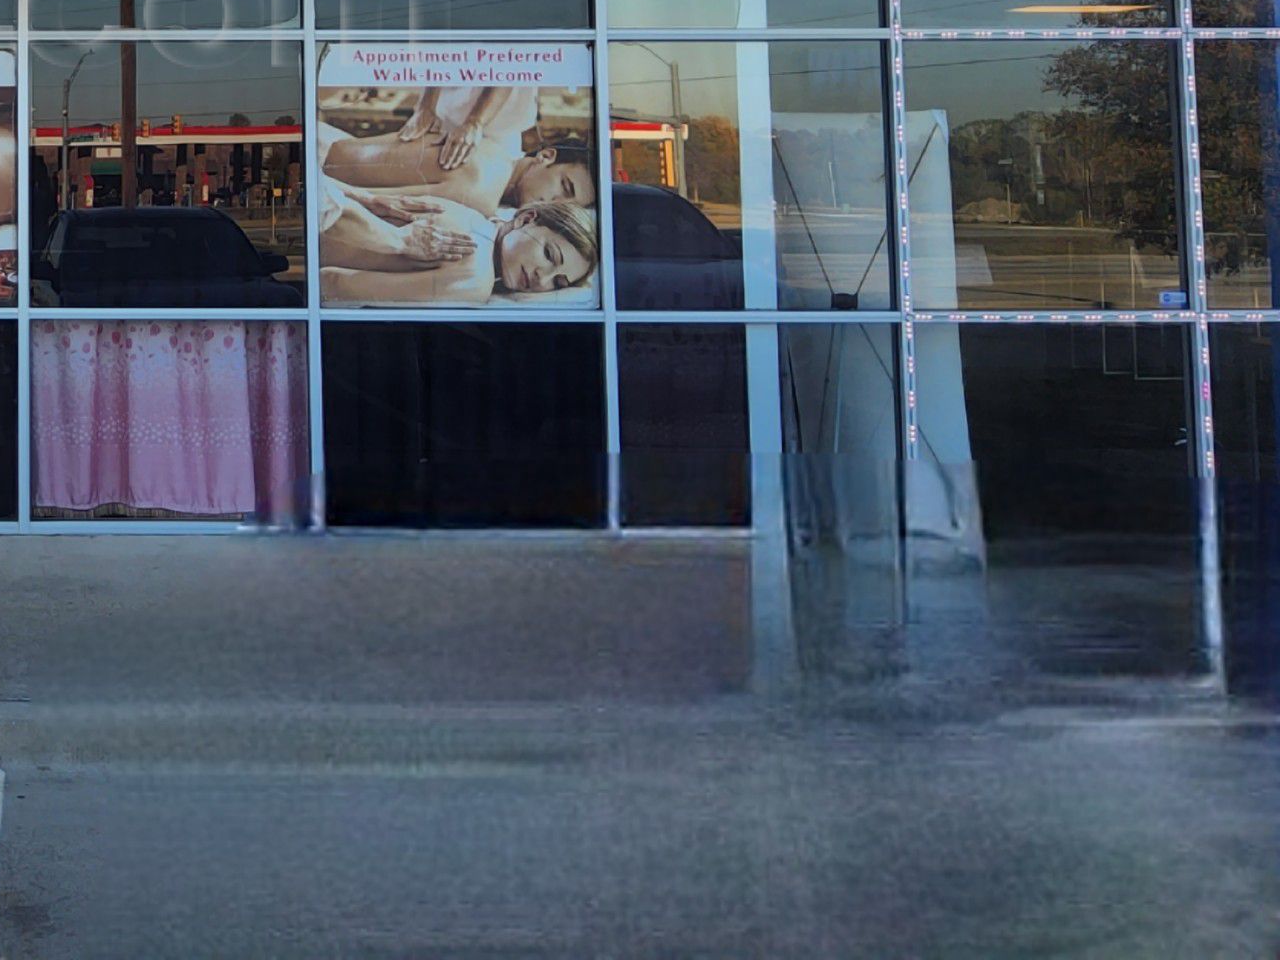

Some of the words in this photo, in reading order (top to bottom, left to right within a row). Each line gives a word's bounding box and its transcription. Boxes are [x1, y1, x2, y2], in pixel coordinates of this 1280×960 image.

[353, 48, 468, 66] Appointment
[477, 47, 563, 63] Preferred
[373, 67, 451, 82] Walk-Ins
[459, 67, 543, 82] Welcome
